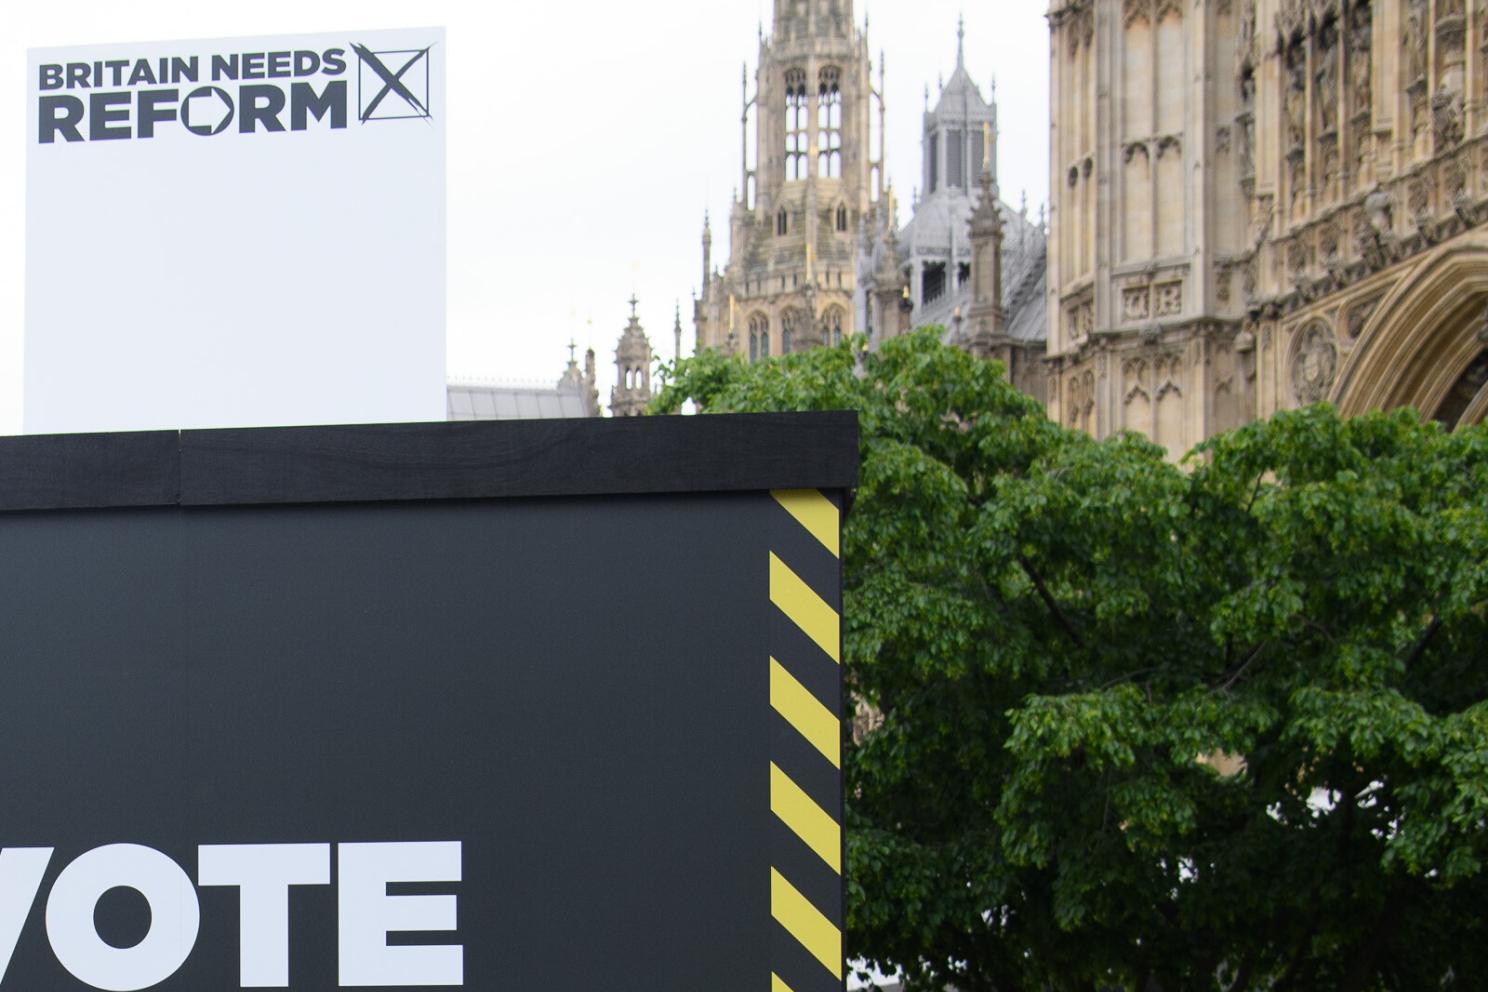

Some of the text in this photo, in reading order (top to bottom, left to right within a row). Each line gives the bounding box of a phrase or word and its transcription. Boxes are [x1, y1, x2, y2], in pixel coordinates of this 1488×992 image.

[38, 47, 348, 91] BRITAIN NEEDS
[38, 79, 348, 145] REFORM
